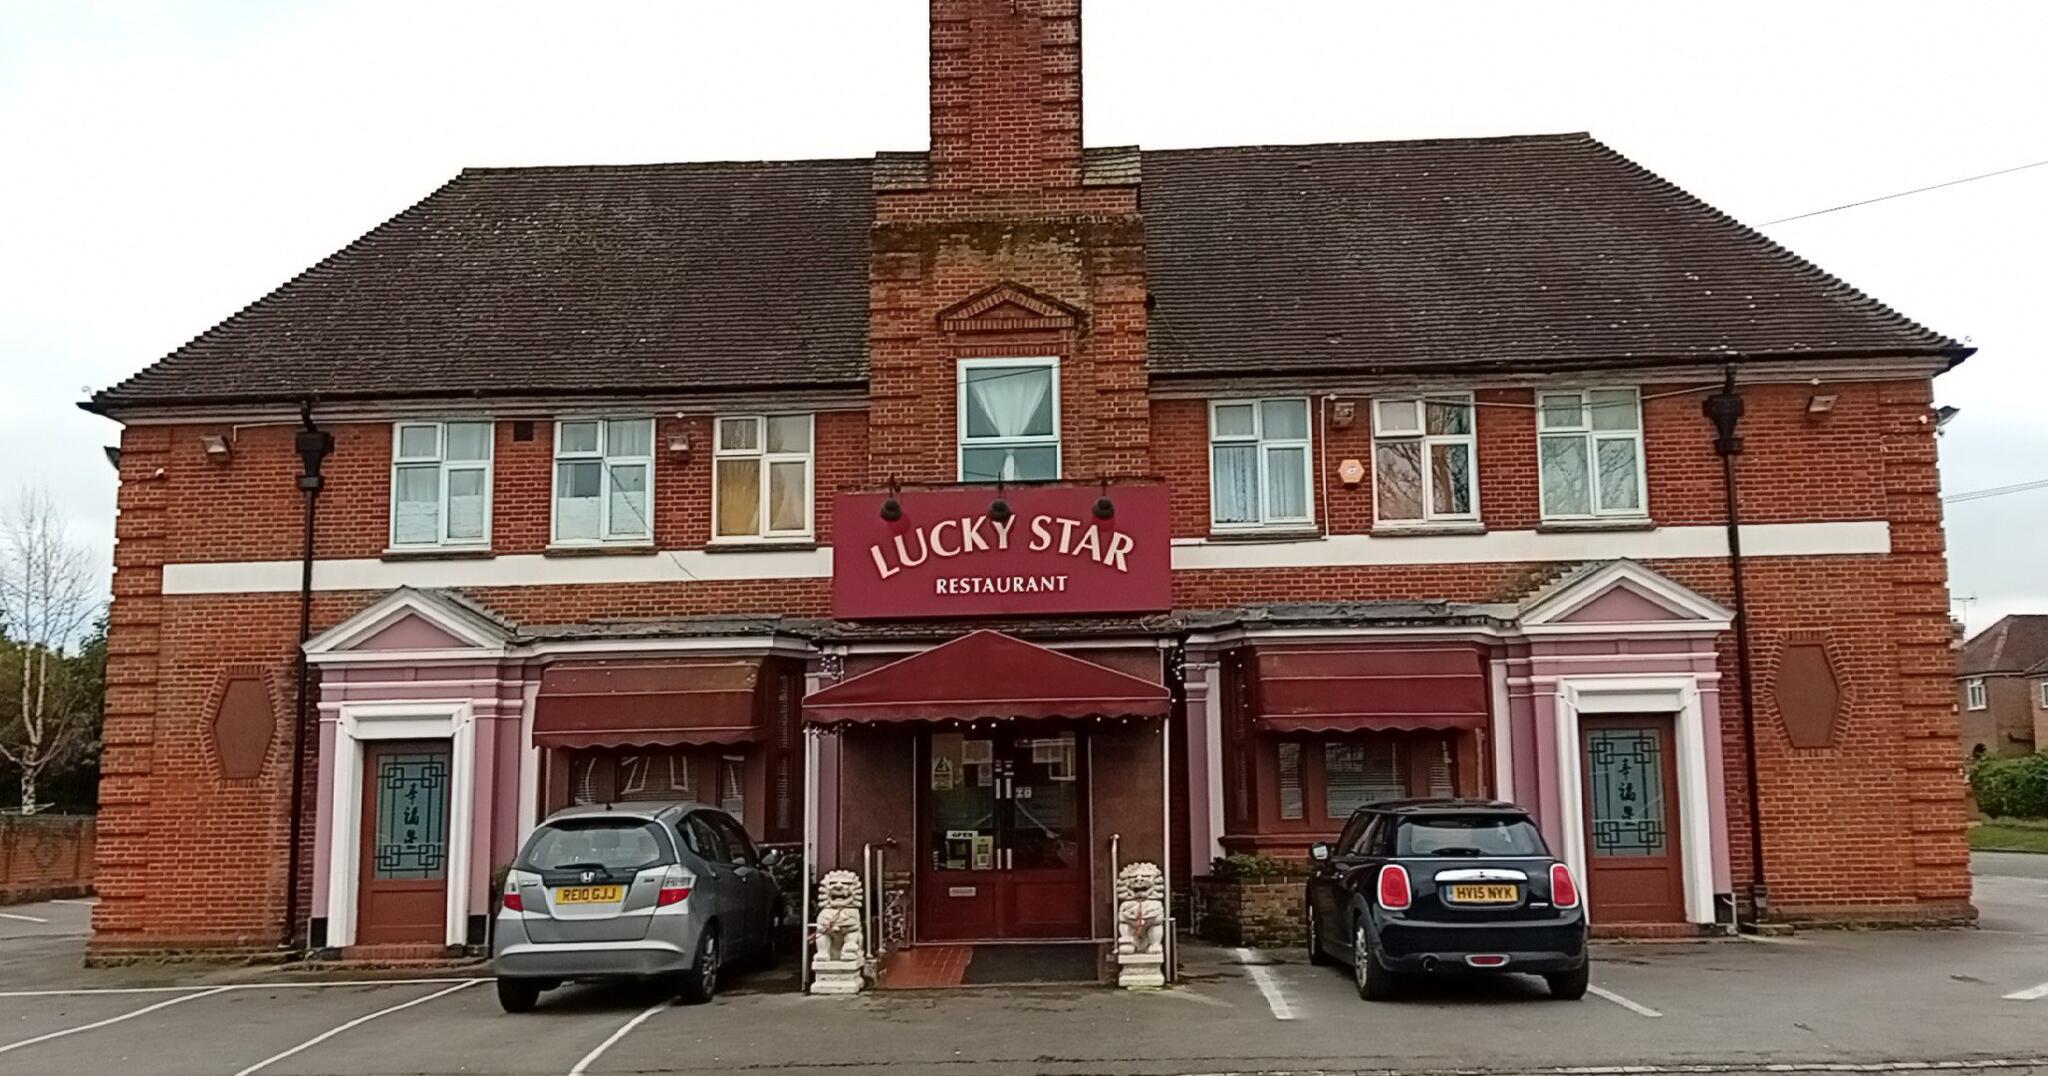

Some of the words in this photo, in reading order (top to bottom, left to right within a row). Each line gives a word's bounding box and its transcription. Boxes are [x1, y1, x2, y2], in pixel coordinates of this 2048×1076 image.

[870, 516, 1016, 579] LUCKY
[1029, 516, 1134, 572] STAR
[935, 576, 1069, 595] RESTAURANT
[562, 888, 589, 901] RE10
[591, 887, 615, 900] GJJ
[1488, 886, 1513, 899] NYK
